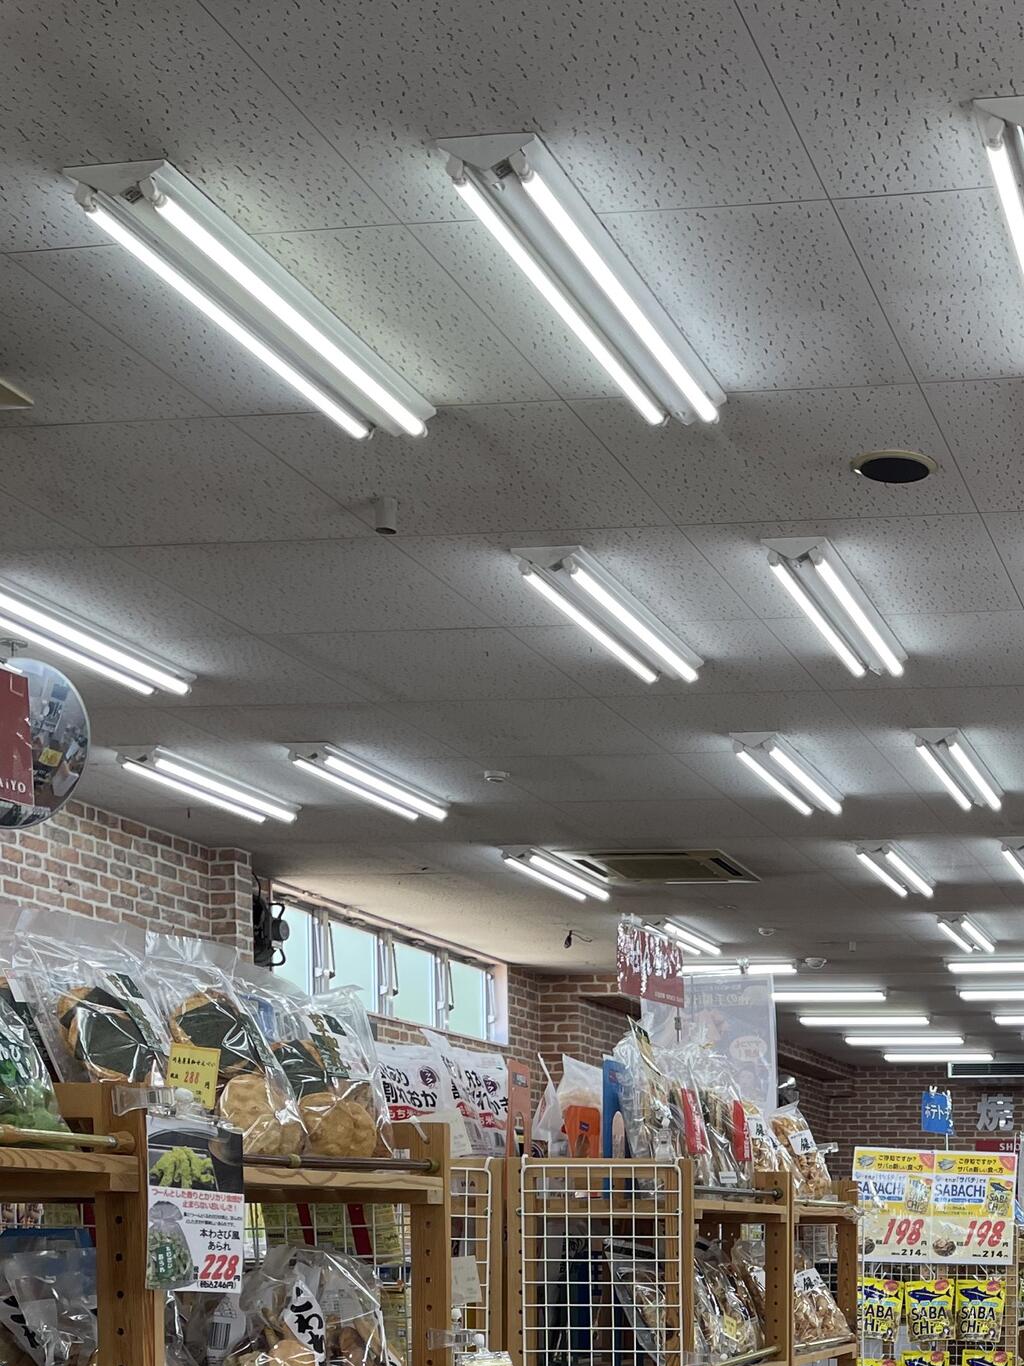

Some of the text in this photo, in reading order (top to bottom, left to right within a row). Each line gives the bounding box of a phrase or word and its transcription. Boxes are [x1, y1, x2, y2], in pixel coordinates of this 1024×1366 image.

[183, 1071, 200, 1085] 288
[877, 1154, 917, 1163] ご存知ですか?
[959, 1157, 997, 1166] ご存知ですか?
[877, 1163, 923, 1172] サバの新しい食べ方
[957, 1166, 1004, 1174] サバの新しい食べ方
[934, 1183, 986, 1198] SABACHi
[200, 1229, 241, 1240] 本わさび風
[883, 1218, 925, 1246] 198
[964, 1220, 1006, 1248] 198
[207, 1241, 232, 1251] あられ
[982, 1250, 1003, 1258] 214
[200, 1254, 240, 1281] 228
[911, 1306, 948, 1320] SABA
[960, 1305, 996, 1320] SABA
[912, 1321, 934, 1336] CHi
[960, 1320, 982, 1334] CHi
